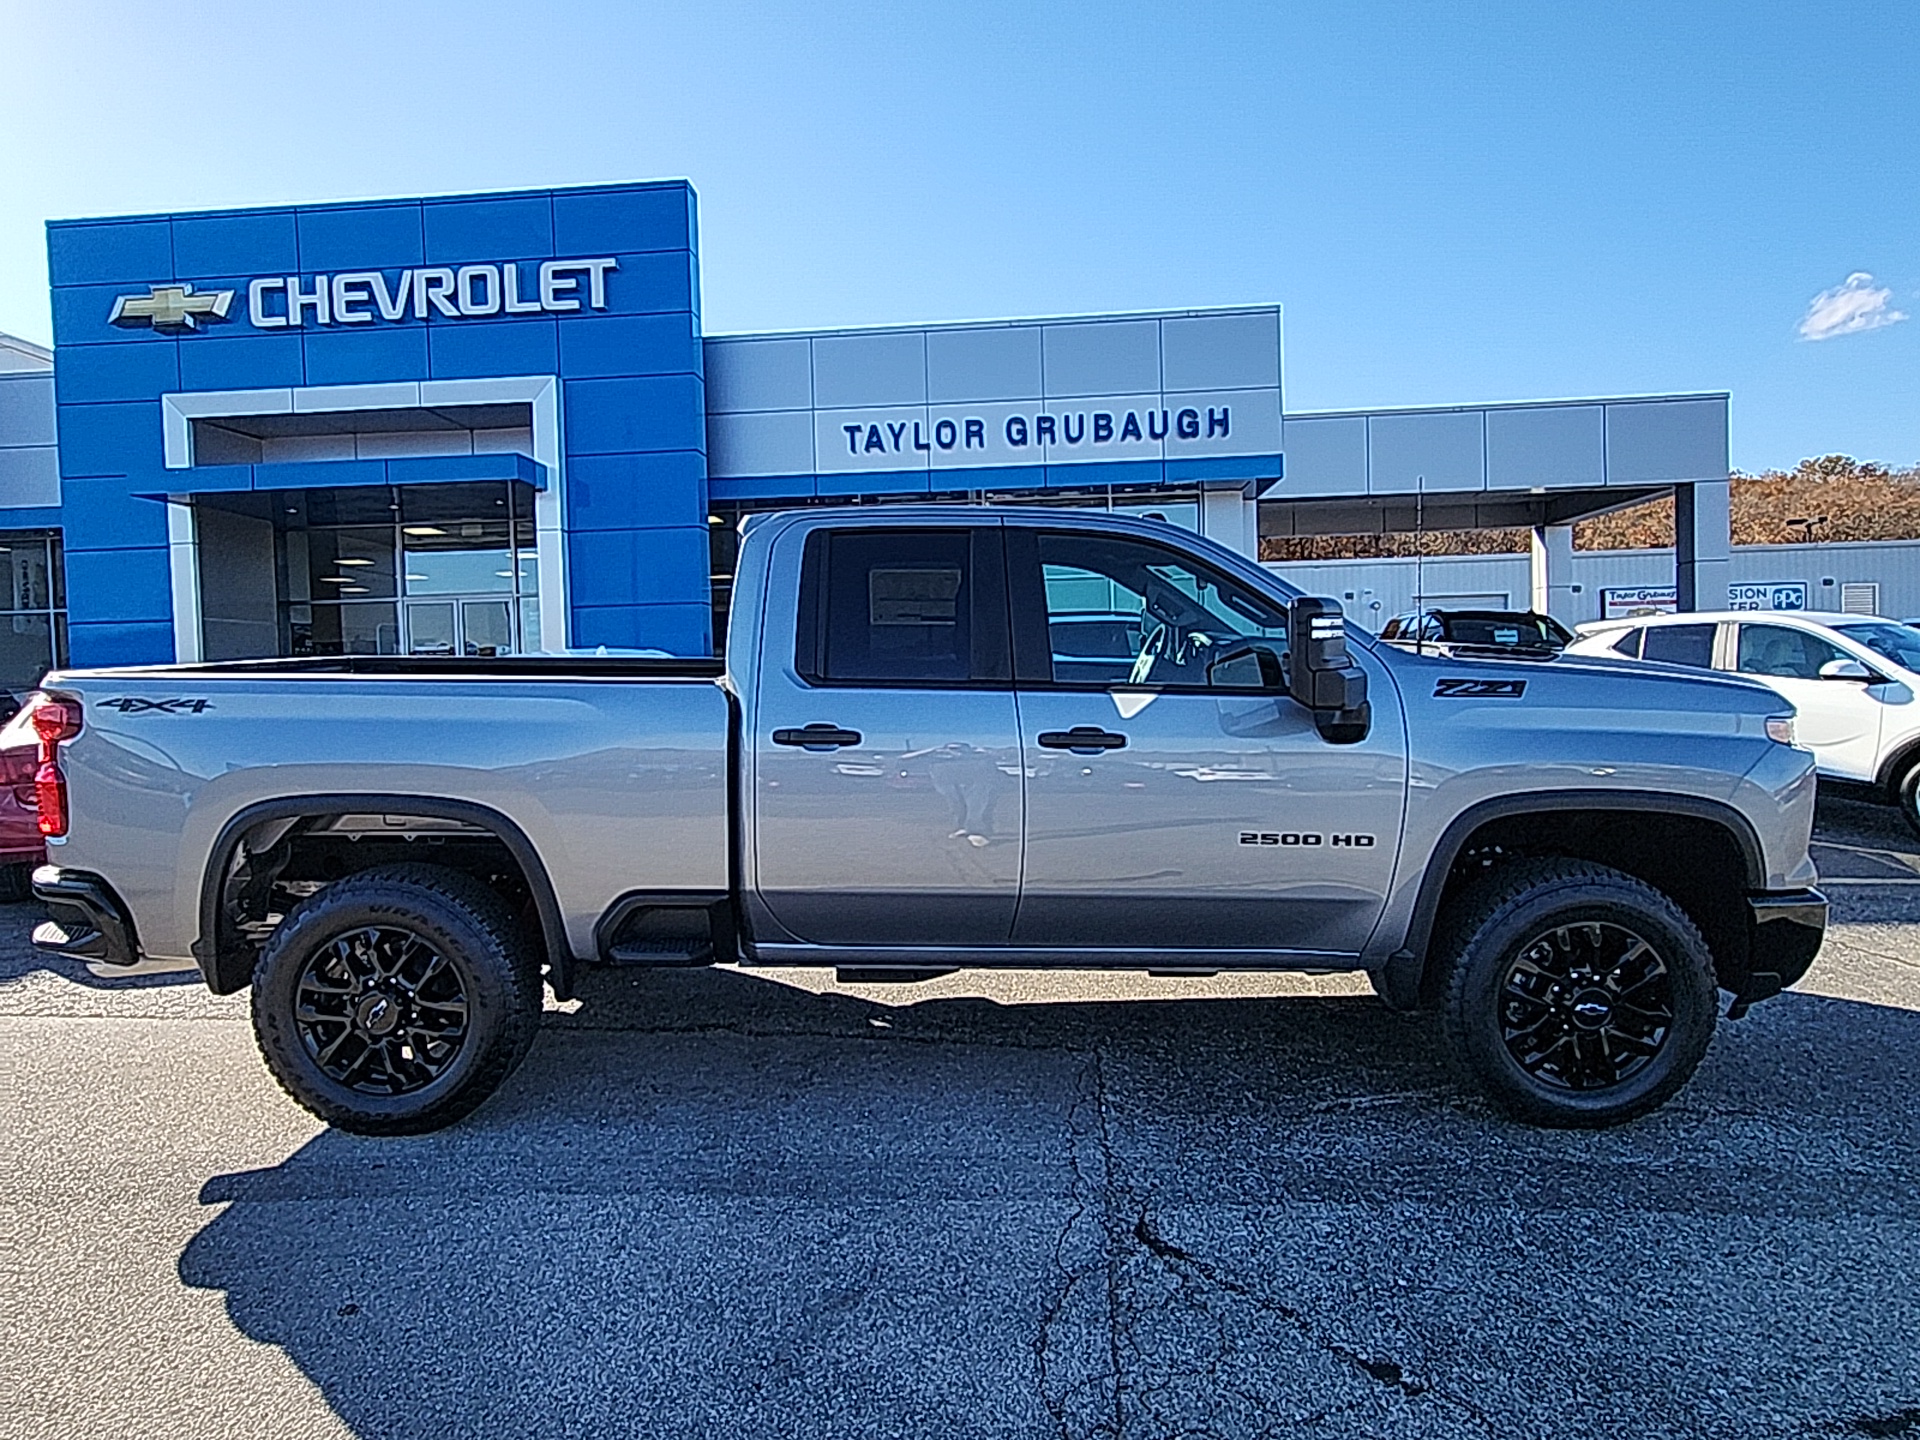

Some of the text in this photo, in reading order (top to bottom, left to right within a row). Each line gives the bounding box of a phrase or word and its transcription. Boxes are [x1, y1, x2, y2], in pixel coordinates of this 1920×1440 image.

[248, 257, 617, 328] CHEVROLET
[843, 407, 1231, 455] TAYLOR GRUBAUGH
[1728, 587, 1767, 600] SION
[1774, 589, 1803, 609] PPG
[1240, 832, 1375, 847] 2500 HD
